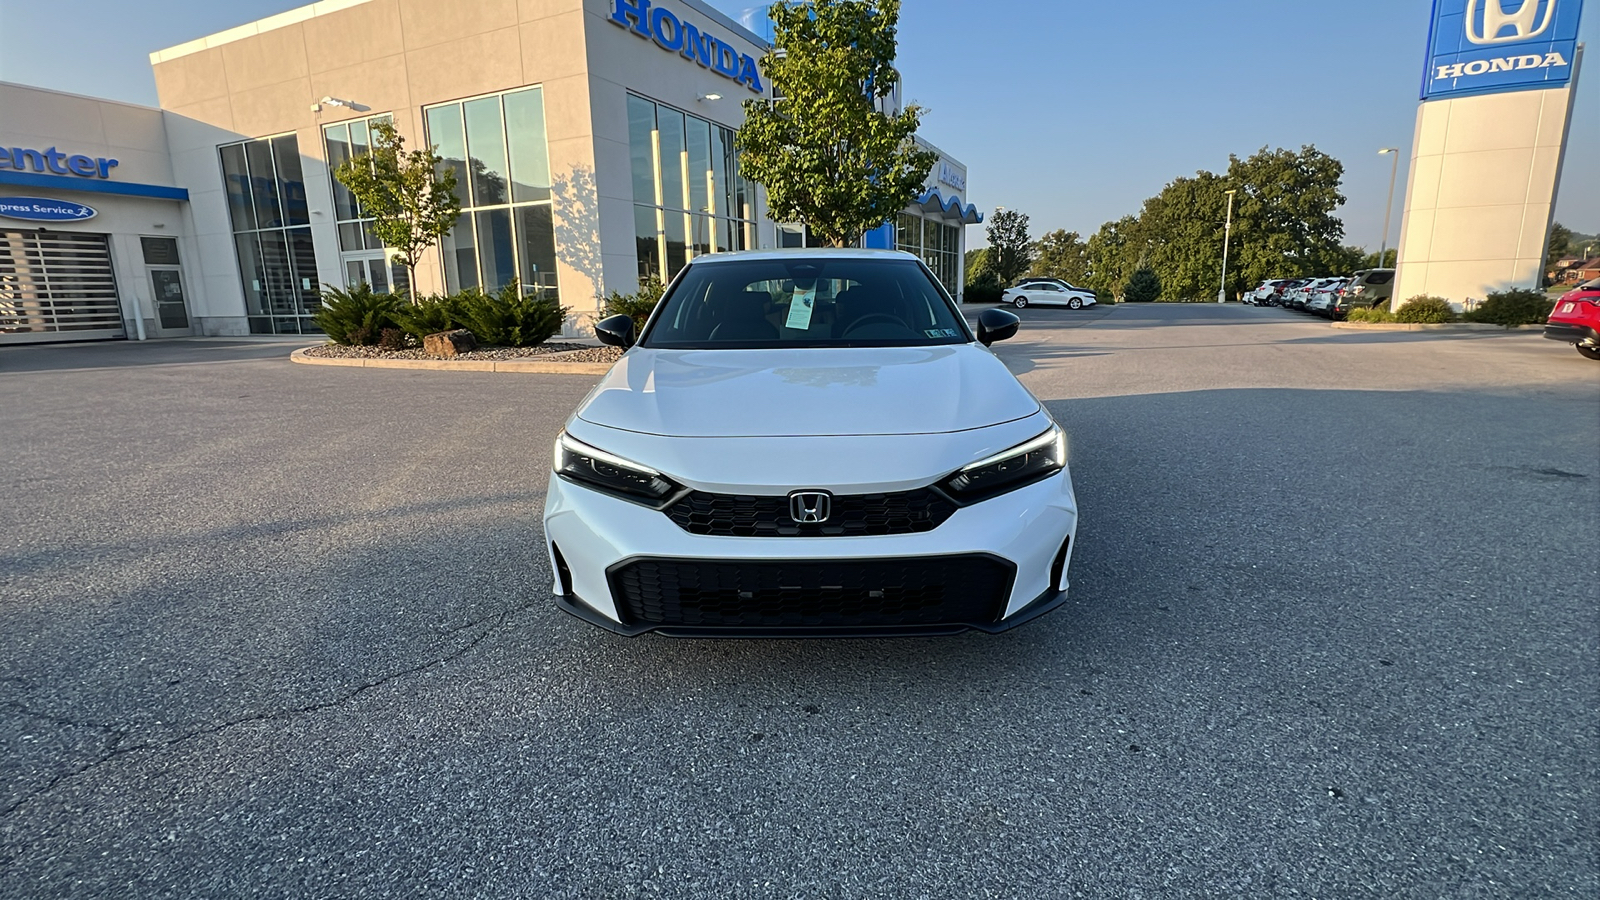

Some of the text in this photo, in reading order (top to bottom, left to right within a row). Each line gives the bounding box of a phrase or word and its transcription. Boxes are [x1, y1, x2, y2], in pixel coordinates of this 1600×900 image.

[609, 0, 763, 93] HONDA
[1435, 52, 1567, 80] HONDA
[33, 204, 74, 215] Service
